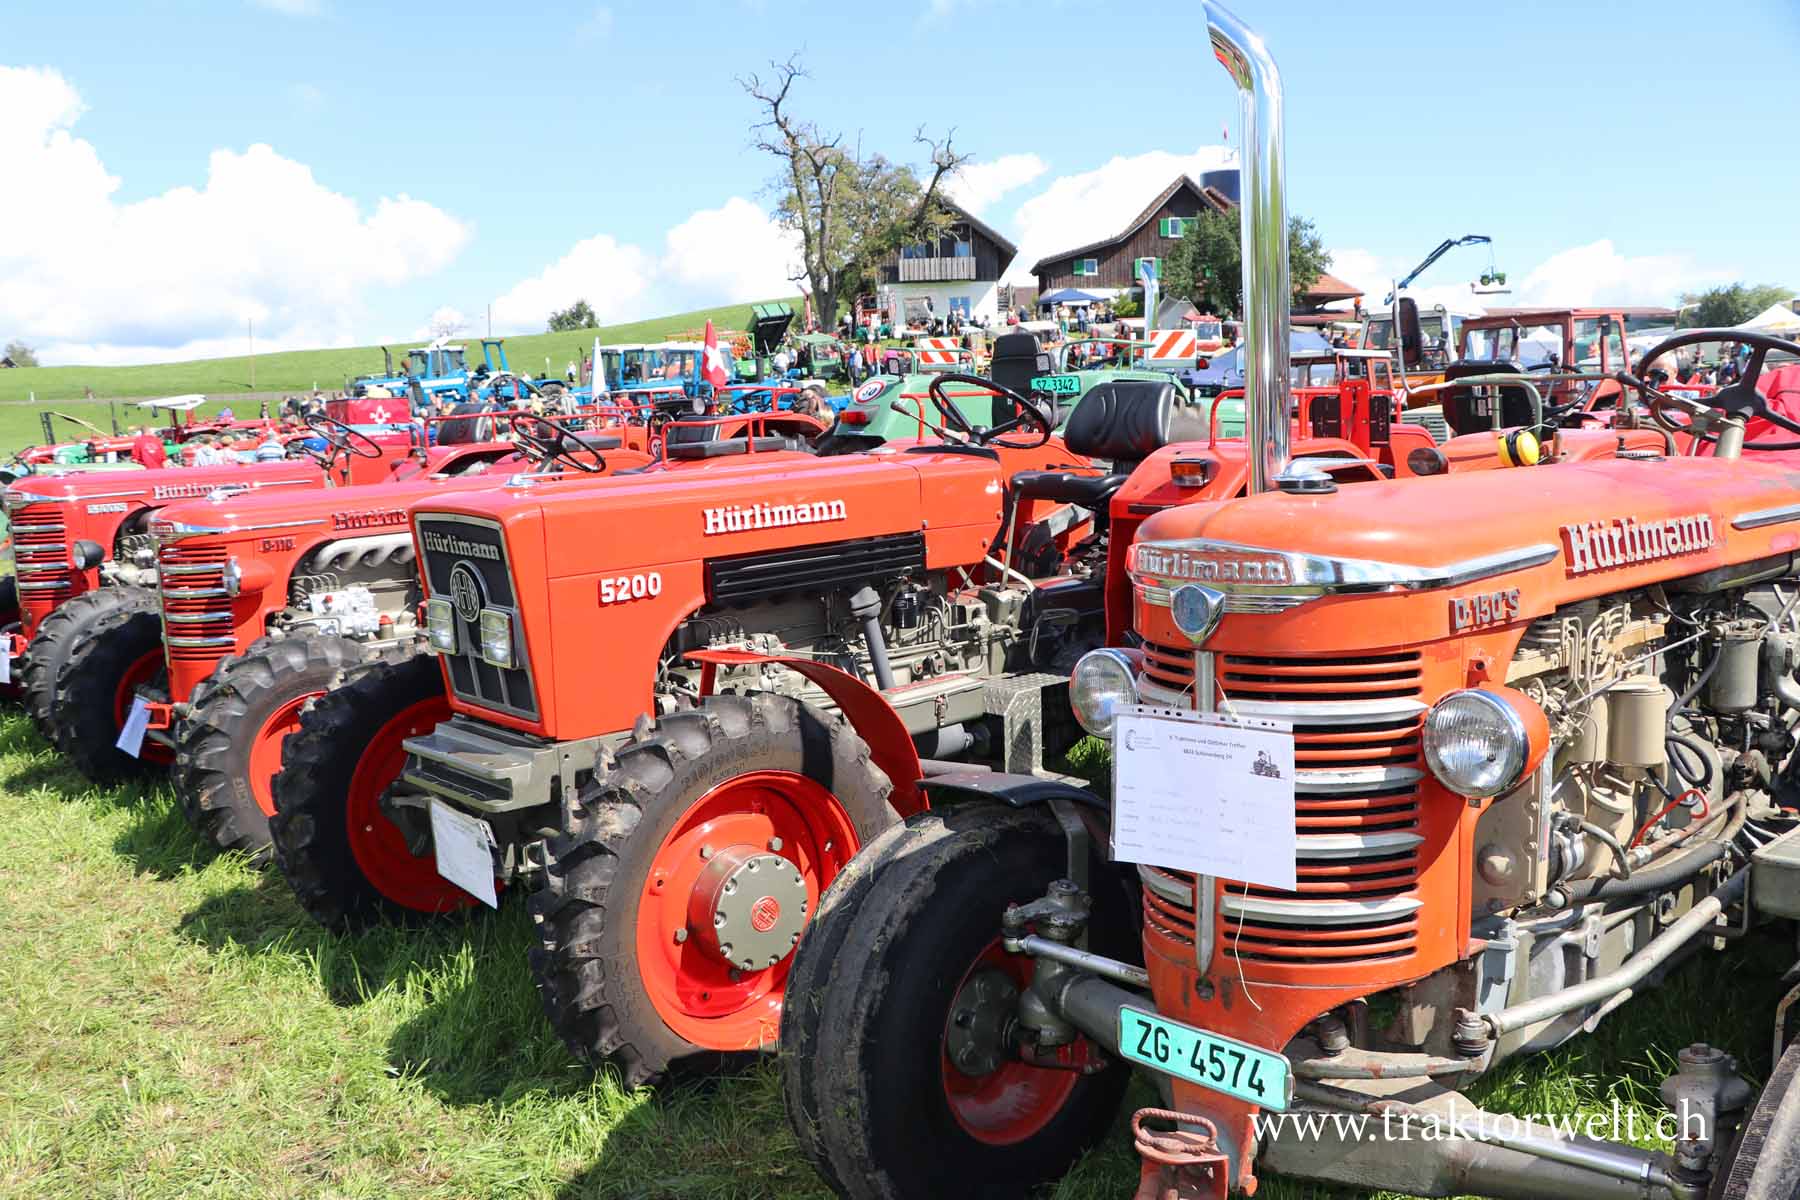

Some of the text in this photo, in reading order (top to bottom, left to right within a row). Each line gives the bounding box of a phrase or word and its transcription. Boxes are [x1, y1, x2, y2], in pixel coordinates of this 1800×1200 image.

[703, 498, 847, 535] Hürlimann
[423, 531, 500, 560] Hürlimann
[1566, 512, 1714, 573] Hürlimann
[1137, 548, 1288, 580] Hürlimann
[600, 572, 662, 603] 5200
